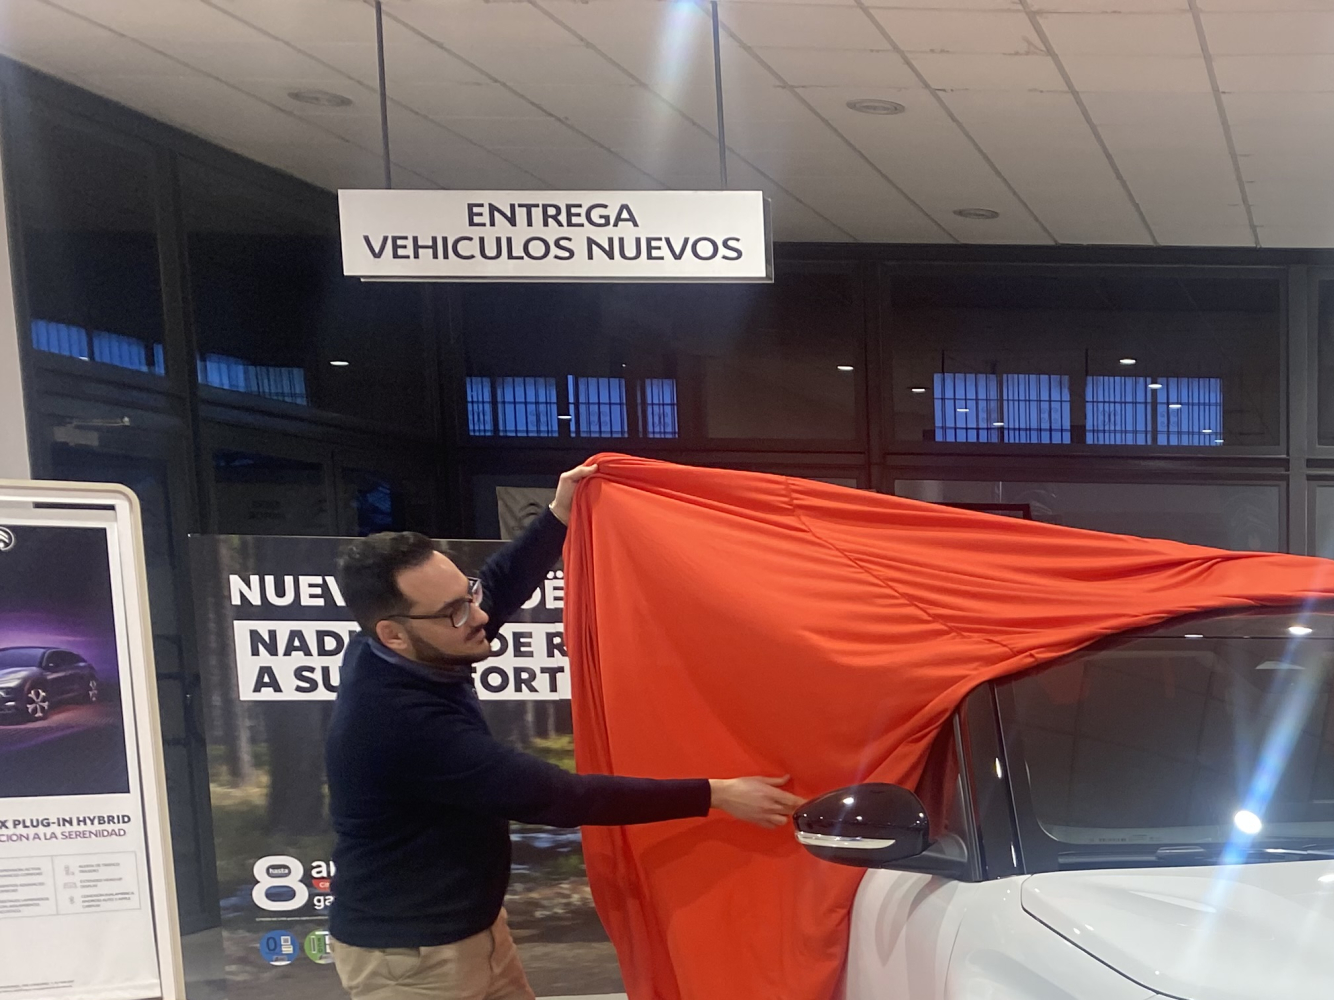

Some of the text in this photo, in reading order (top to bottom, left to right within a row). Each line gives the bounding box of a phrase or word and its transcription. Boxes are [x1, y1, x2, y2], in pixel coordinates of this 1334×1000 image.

[466, 202, 639, 228] ENTREGA
[363, 235, 743, 262] VEHICULOS NUEVOS
[250, 629, 363, 657] NAD
[252, 665, 283, 693] A
[13, 816, 73, 829] PLUG-IN
[76, 814, 131, 826] HYBRID
[32, 832, 42, 841] A
[44, 831, 58, 841] LA
[61, 828, 127, 840] SERENIDAD
[252, 855, 309, 911] 8
